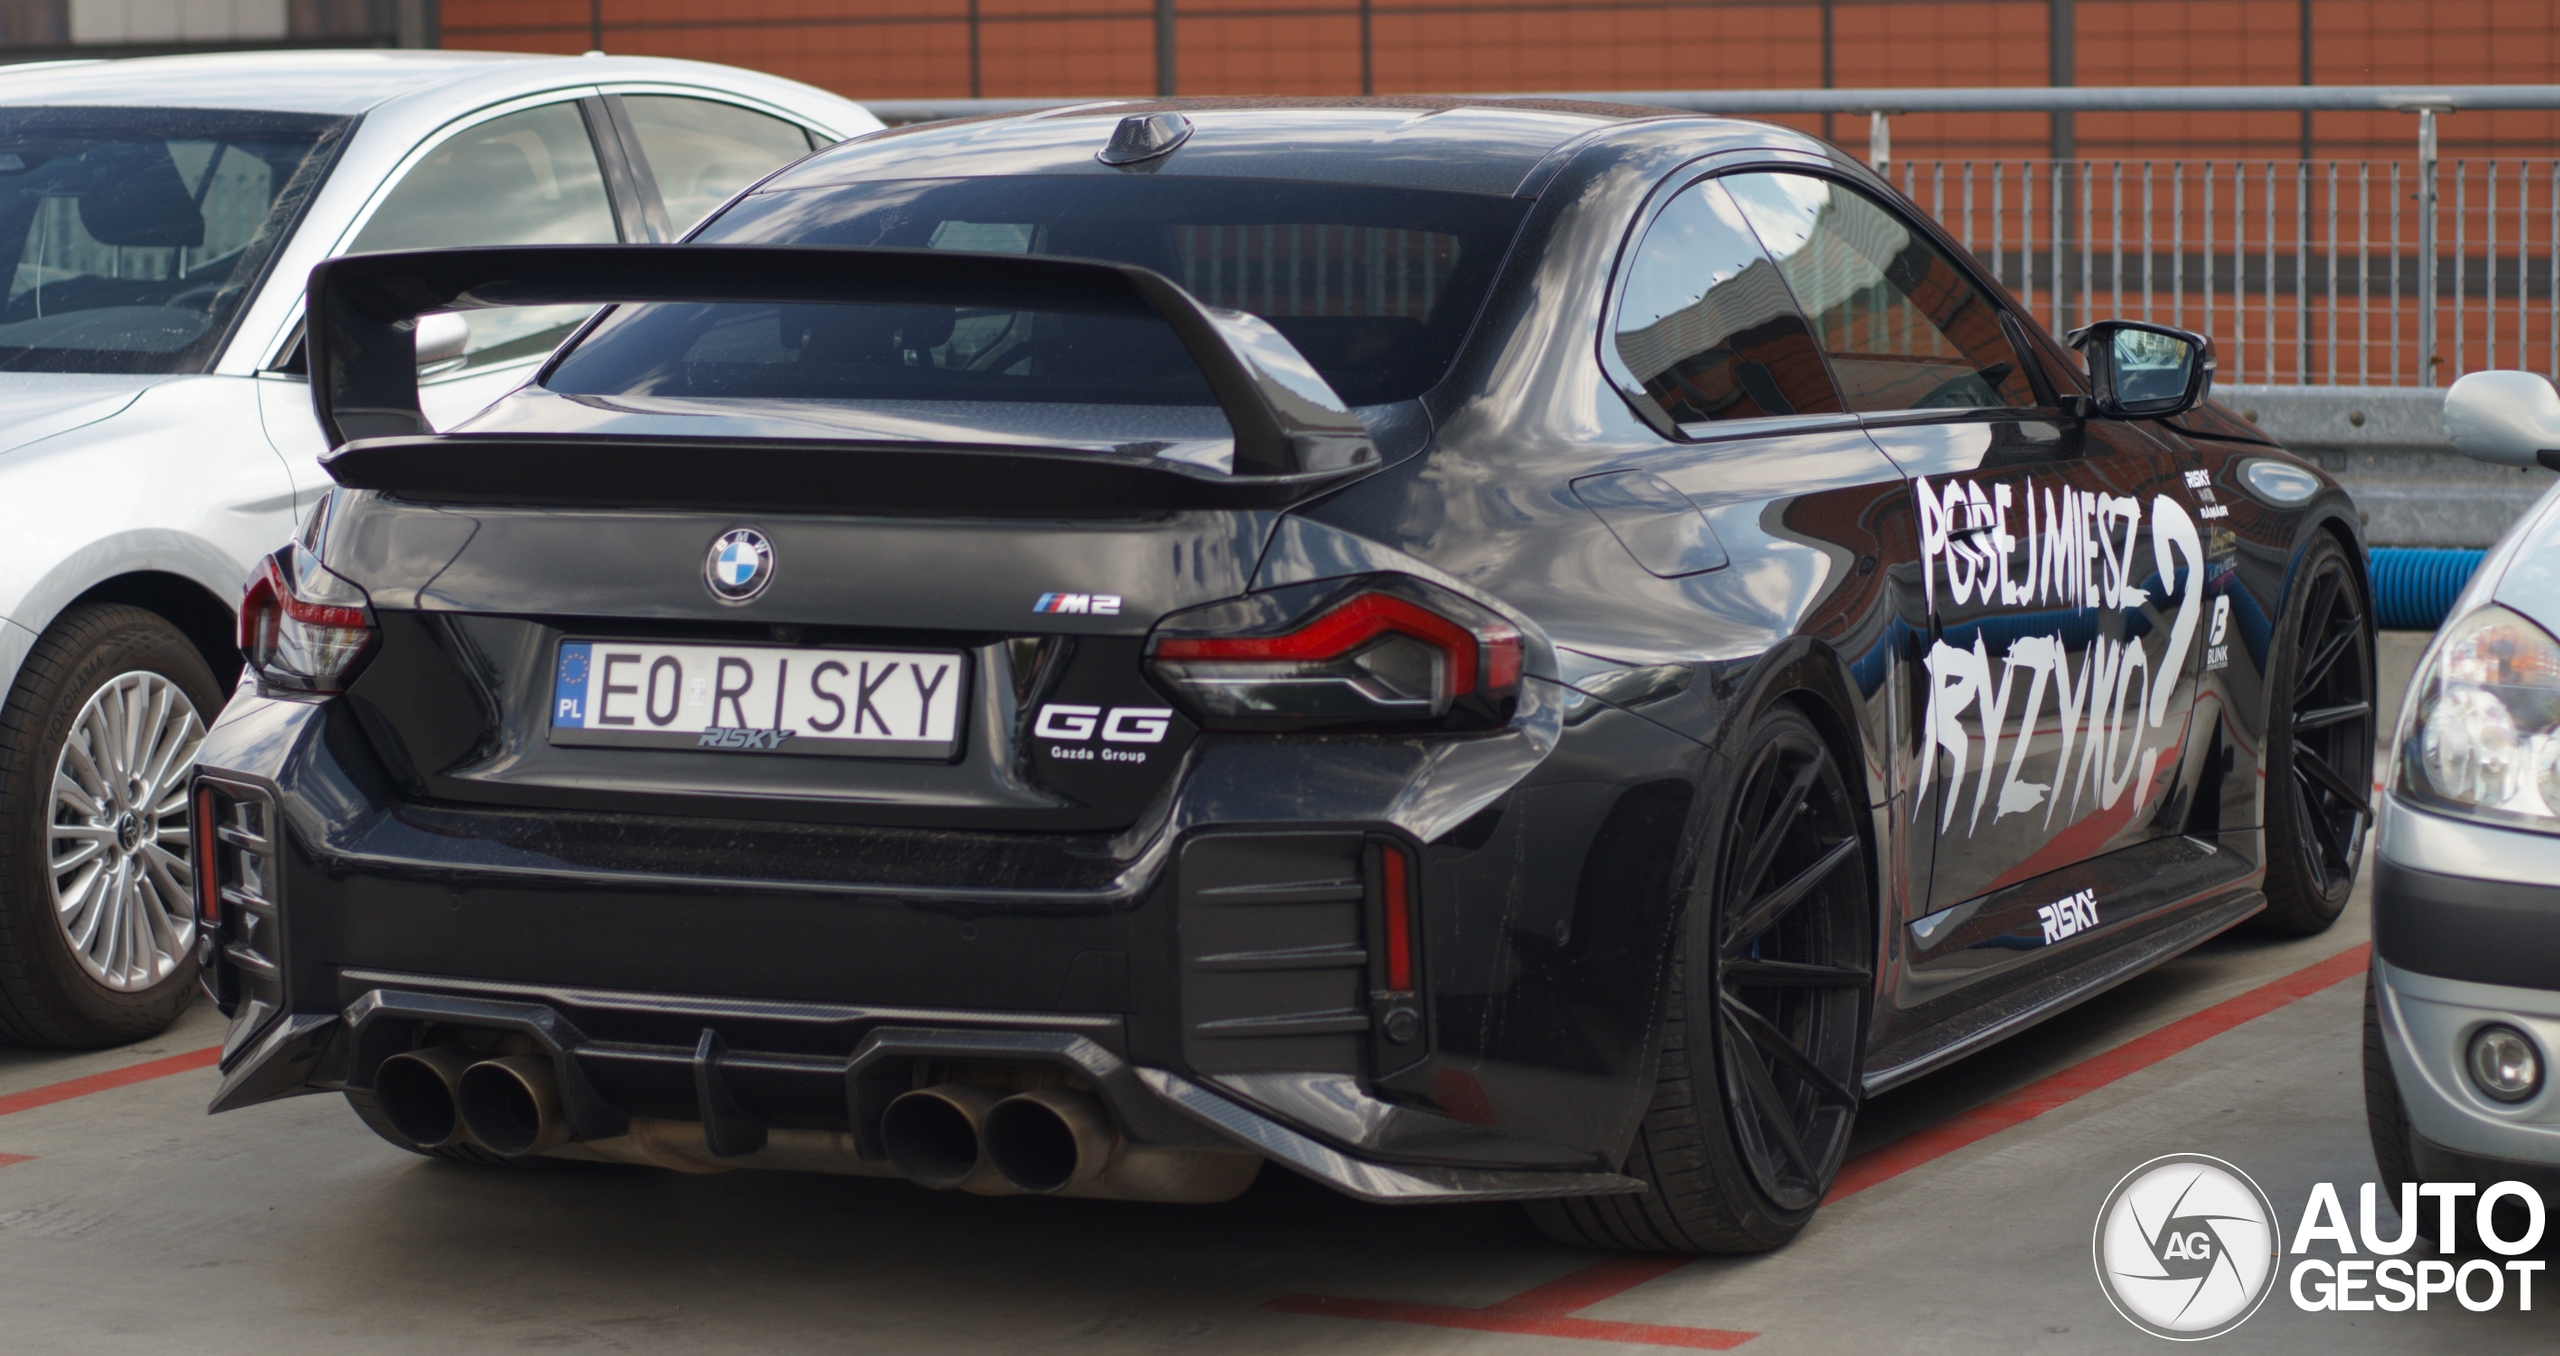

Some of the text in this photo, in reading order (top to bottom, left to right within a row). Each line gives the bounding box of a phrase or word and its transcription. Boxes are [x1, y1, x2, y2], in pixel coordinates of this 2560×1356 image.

[715, 531, 769, 554] BMW
[2209, 555, 2237, 582] LEVEL
[1034, 593, 1121, 615] M2
[2207, 645, 2228, 665] BLINK
[47, 655, 106, 742] YOKOHAMA
[558, 698, 582, 719] PL
[711, 656, 950, 738] RISKY
[1034, 703, 1174, 743] GG
[697, 726, 796, 750] RISKY
[1051, 746, 1146, 764] Gazda Group
[2037, 887, 2099, 946] RISKY
